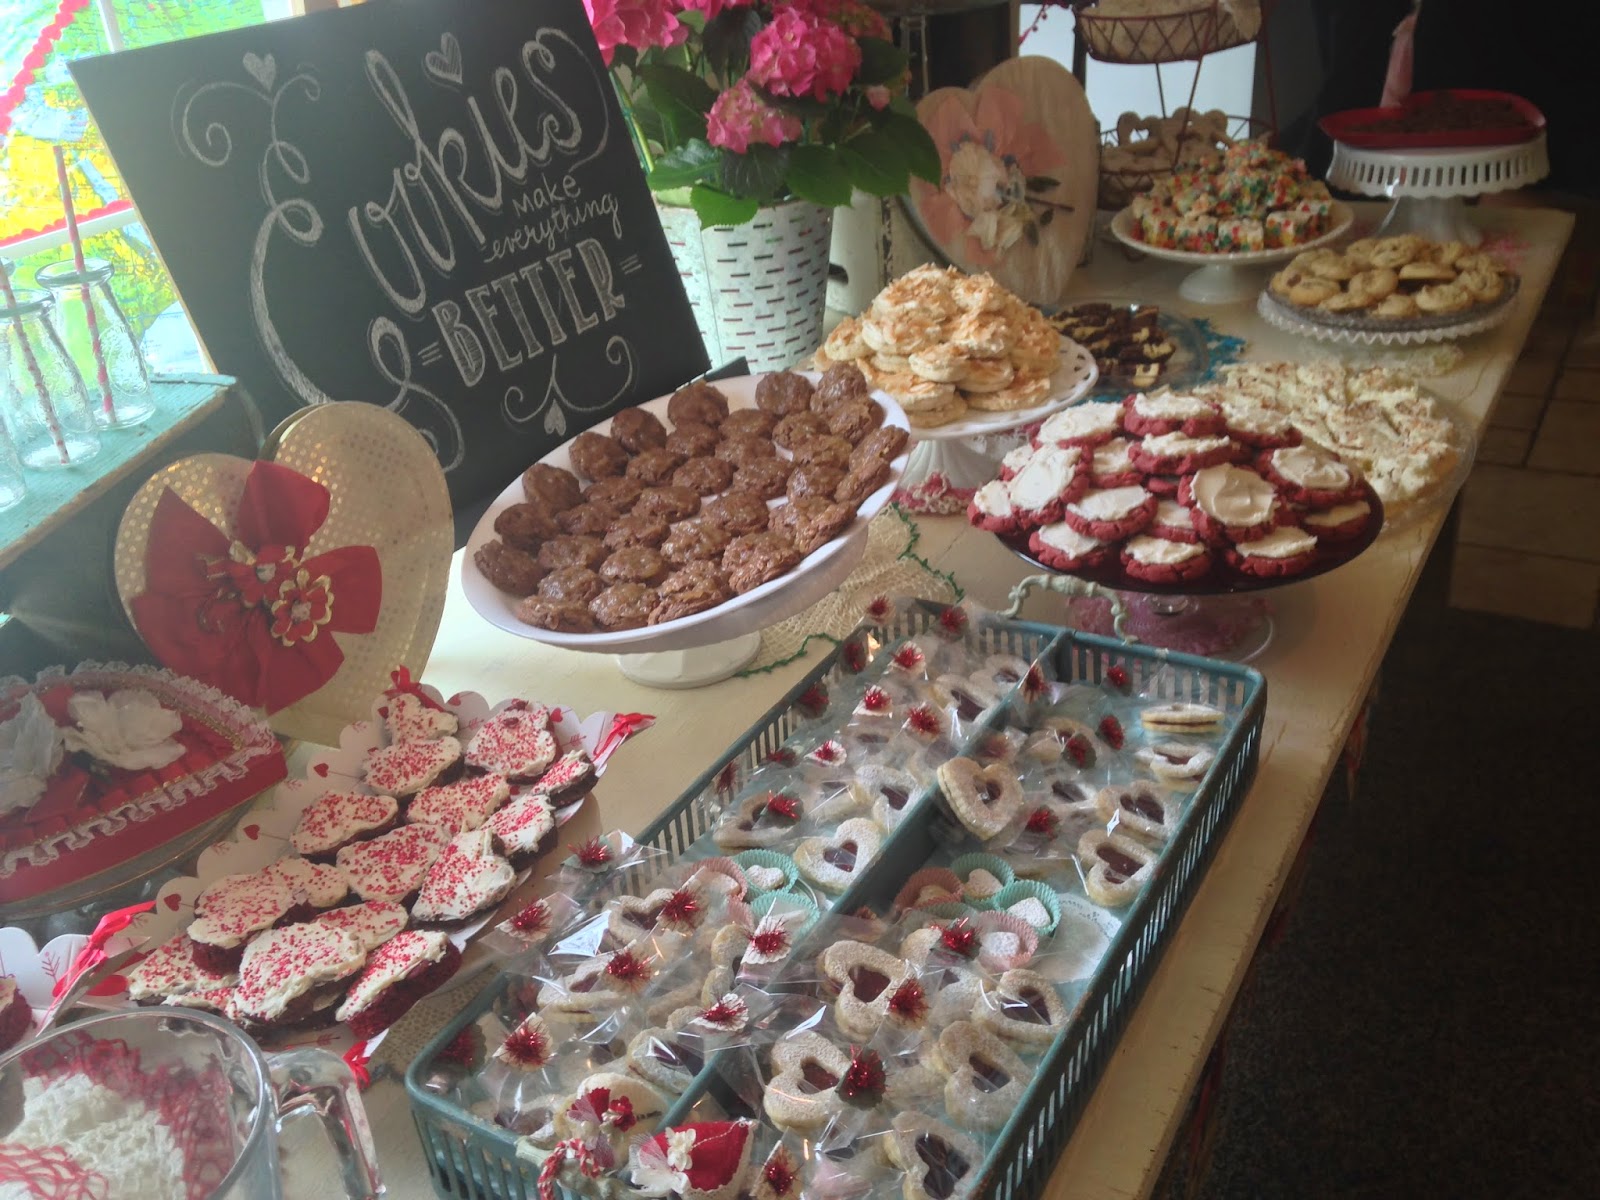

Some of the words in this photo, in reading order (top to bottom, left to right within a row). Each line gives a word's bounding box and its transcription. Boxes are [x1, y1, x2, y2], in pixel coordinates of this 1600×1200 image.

[248, 27, 608, 408] Cookies
[483, 192, 623, 264] everything
[431, 237, 626, 388] BETTER
